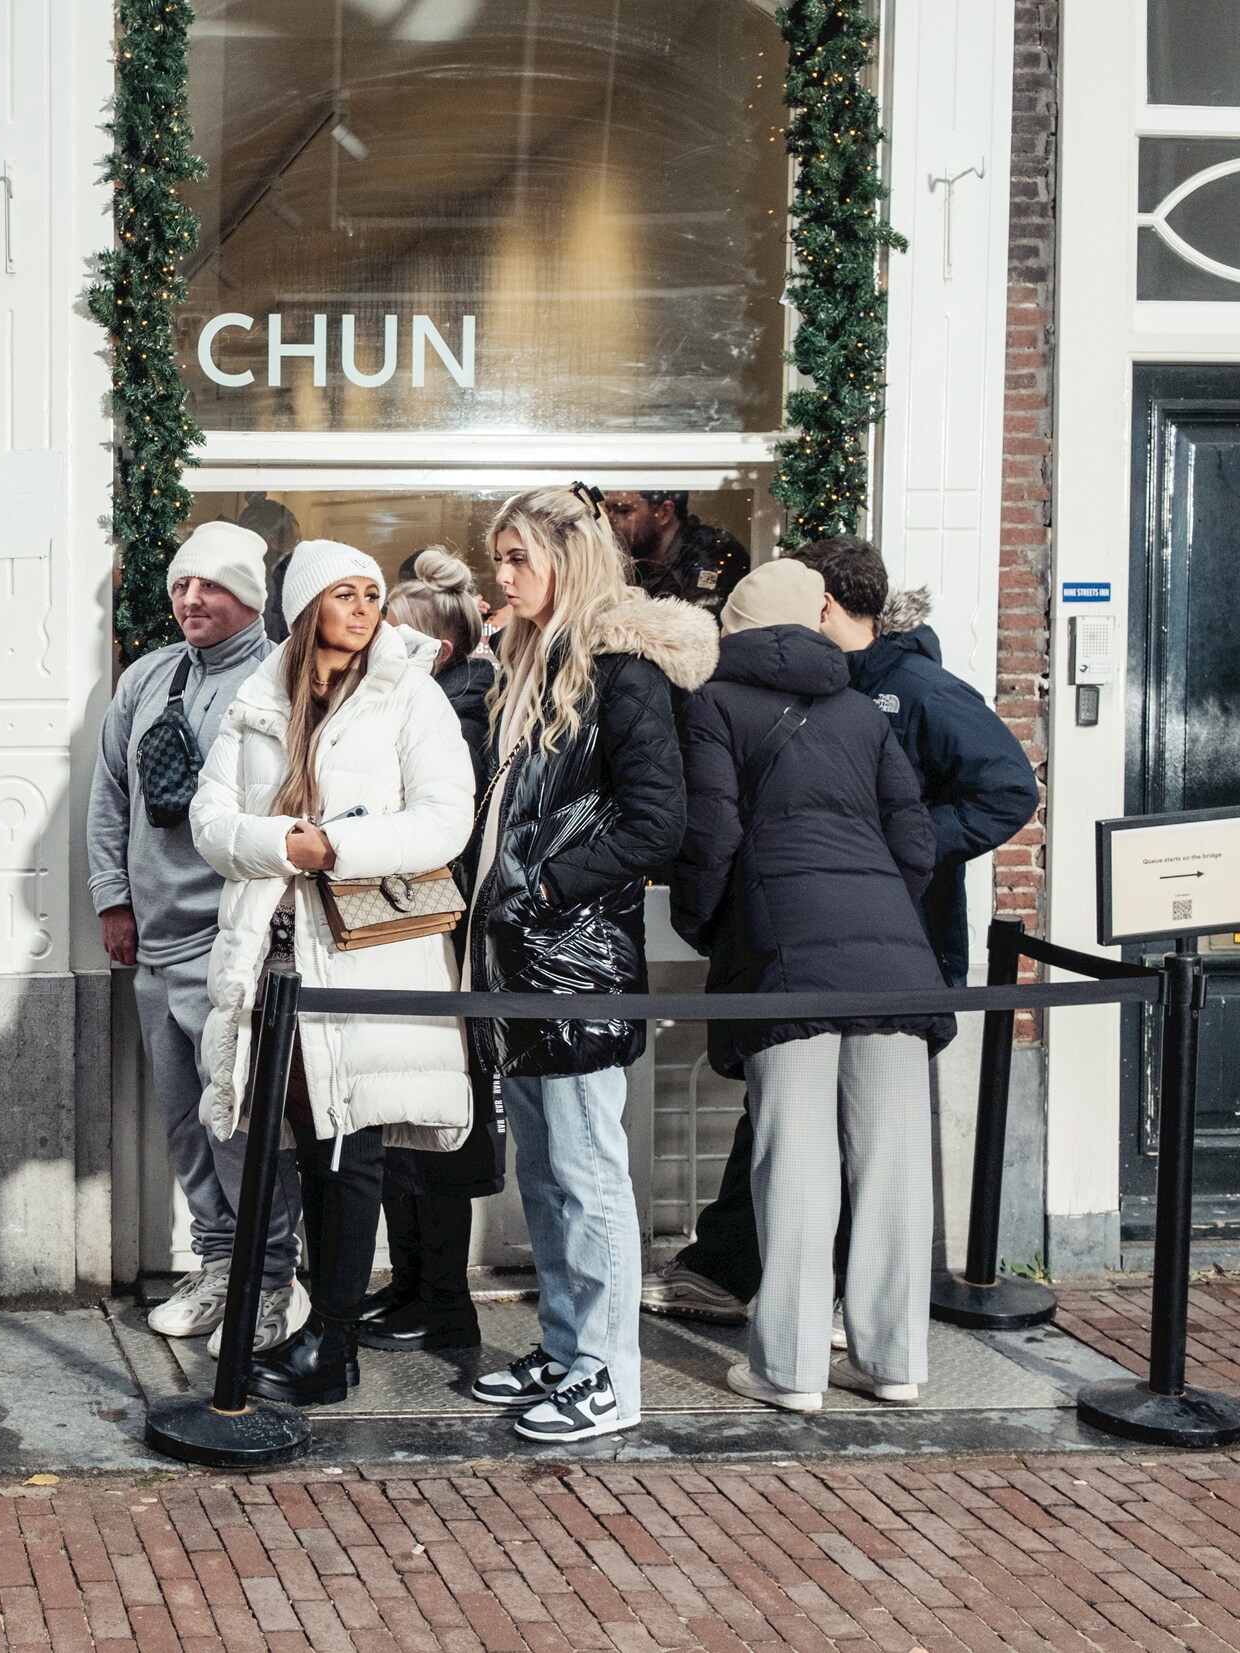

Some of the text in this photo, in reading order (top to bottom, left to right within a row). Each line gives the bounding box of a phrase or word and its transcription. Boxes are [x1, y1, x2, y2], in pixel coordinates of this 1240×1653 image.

[197, 312, 476, 388] CHUN
[1077, 588, 1098, 597] STREETS
[1202, 852, 1222, 860] bridge
[493, 1080, 506, 1133] RVR RVR RVR
